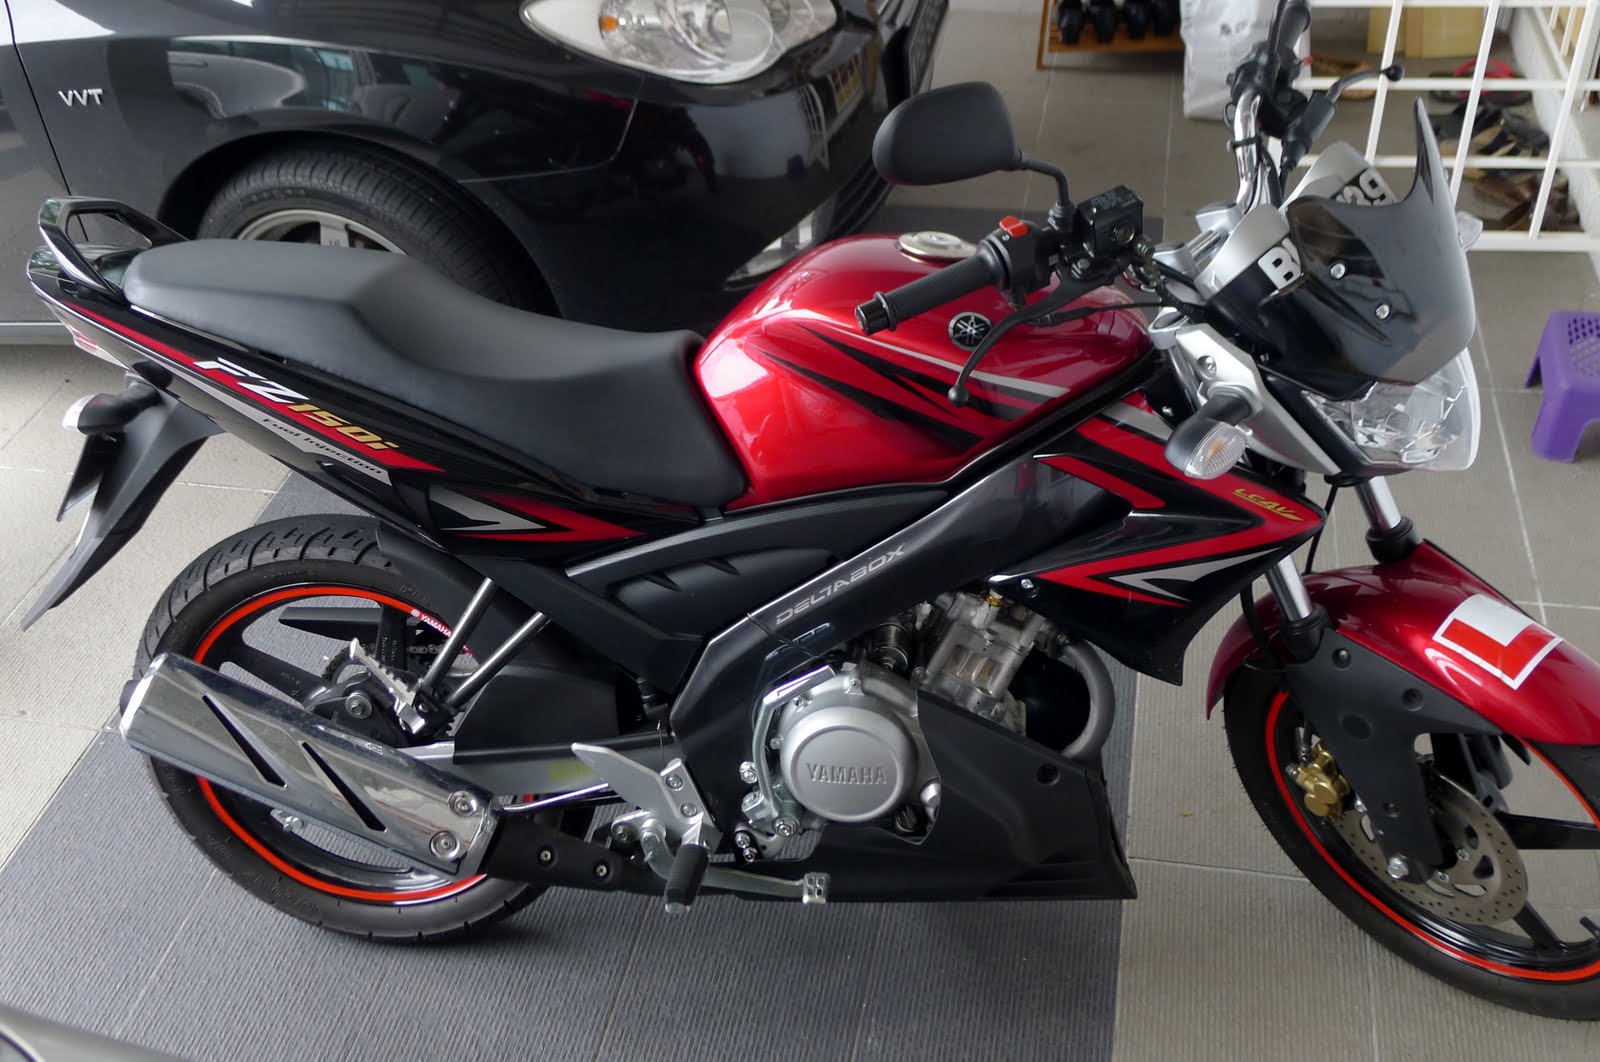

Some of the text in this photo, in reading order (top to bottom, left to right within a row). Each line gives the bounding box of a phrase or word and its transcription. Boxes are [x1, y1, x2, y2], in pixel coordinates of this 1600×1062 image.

[58, 88, 104, 107] VVT
[262, 417, 383, 474] Fuel Injection
[776, 542, 905, 625] DELTABOX
[420, 613, 453, 638] YAMAHA
[1441, 617, 1557, 681] L
[805, 762, 887, 785] YAMAHA
